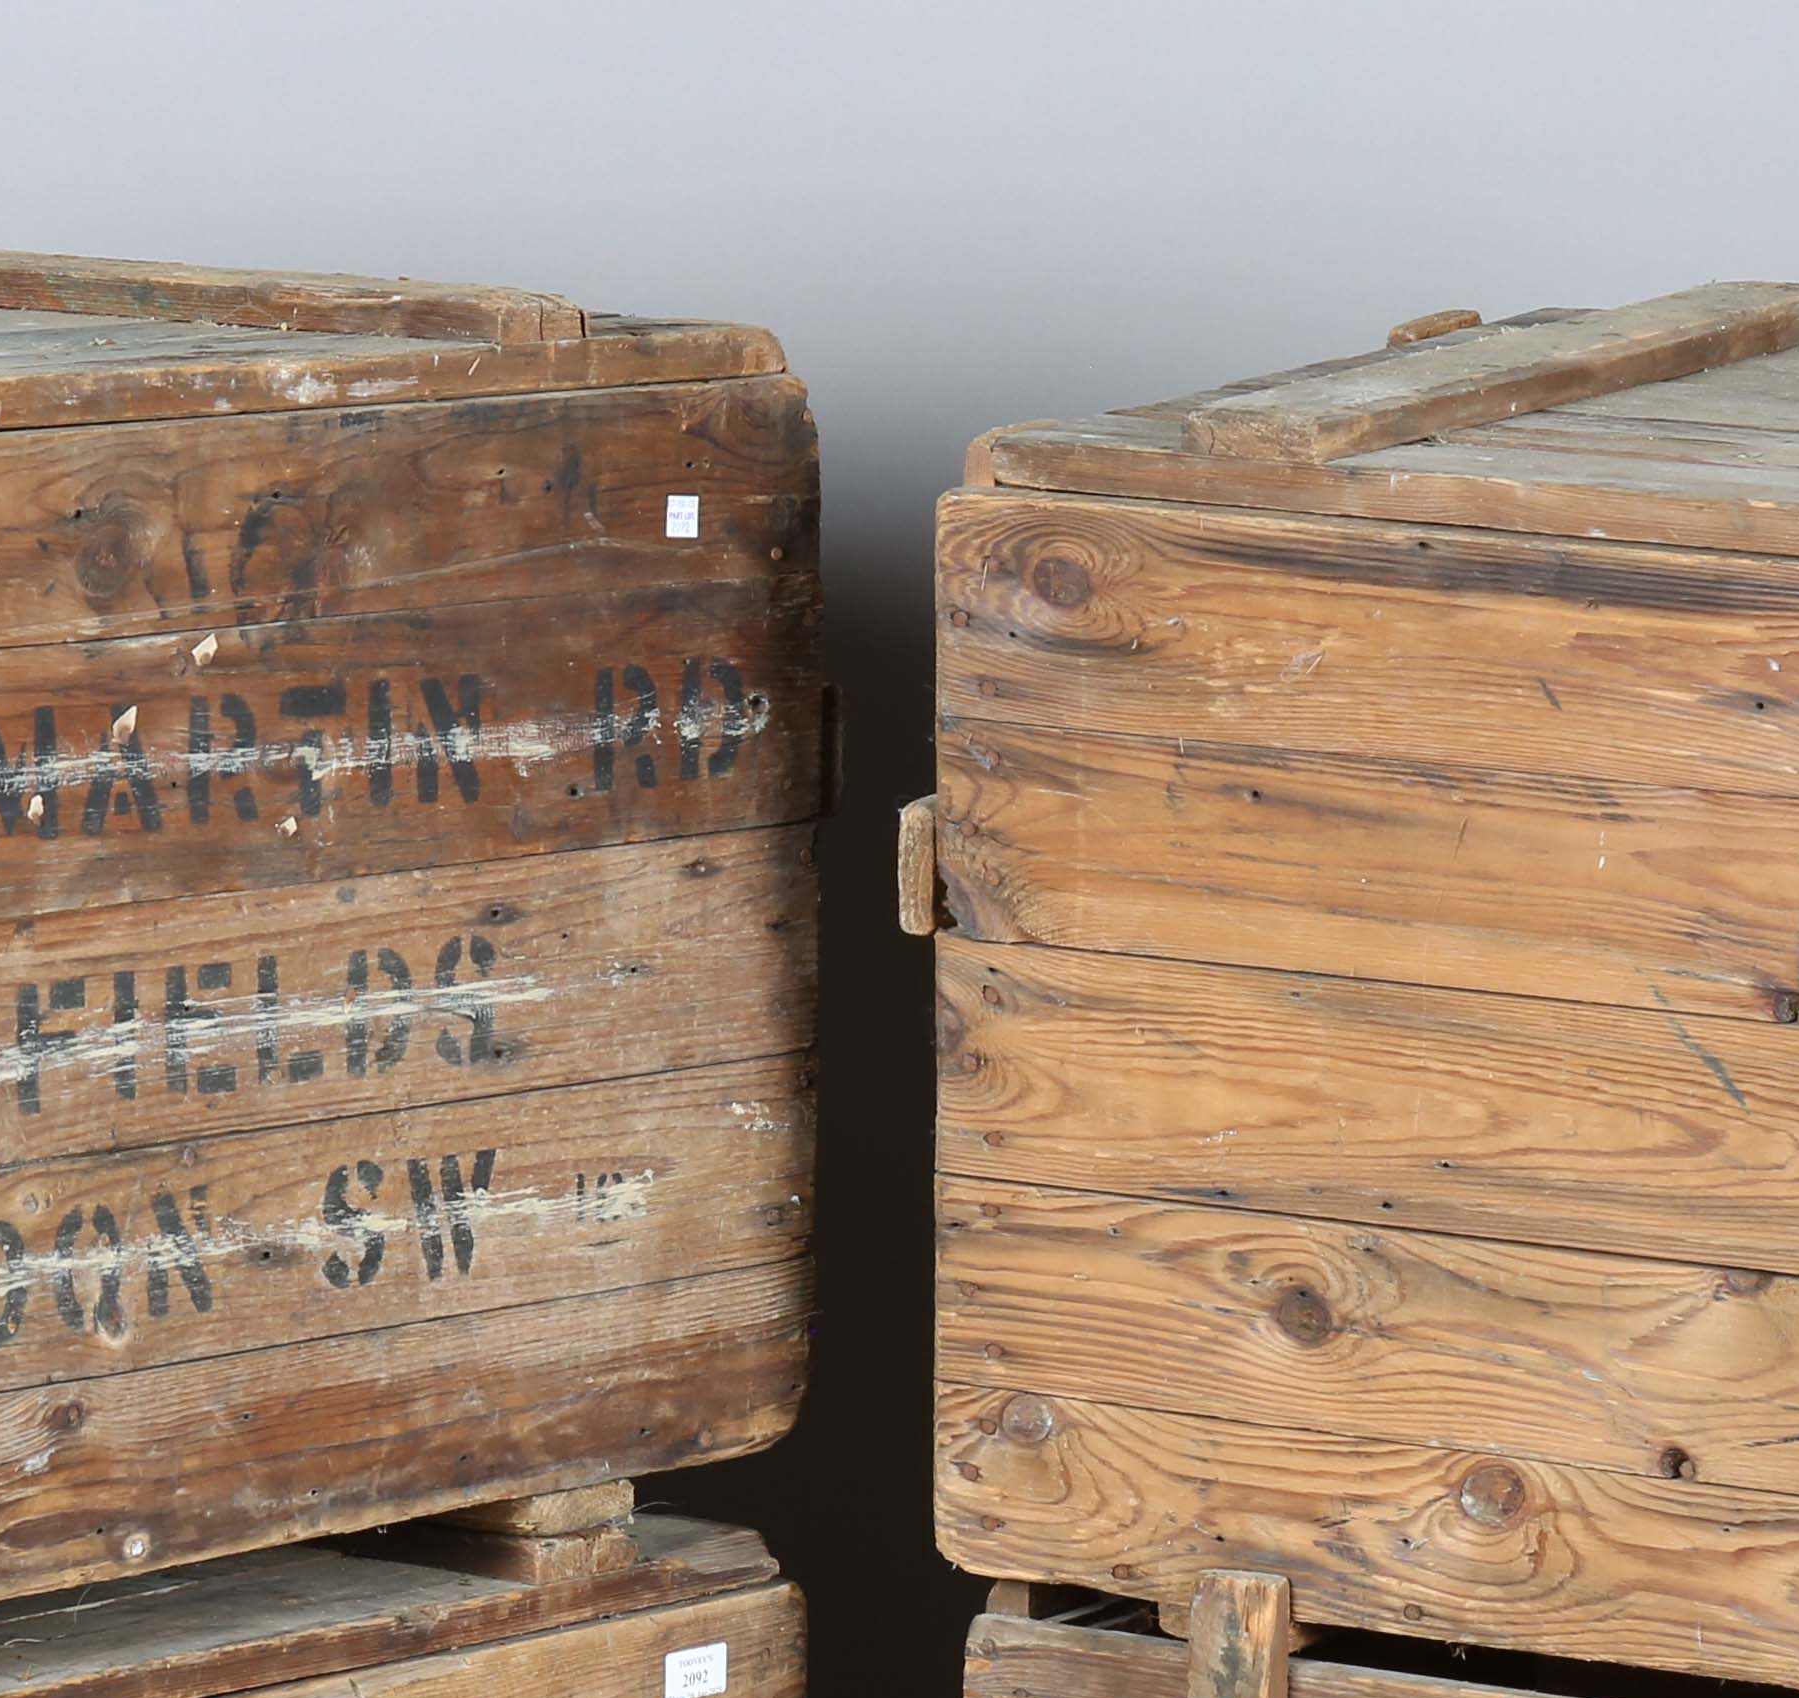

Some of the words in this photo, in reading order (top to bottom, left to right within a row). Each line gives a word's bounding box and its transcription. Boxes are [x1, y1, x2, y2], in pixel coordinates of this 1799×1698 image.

[593, 656, 747, 792] RD
[322, 1148, 497, 1290] SW
[681, 1668, 708, 1689] 2092
